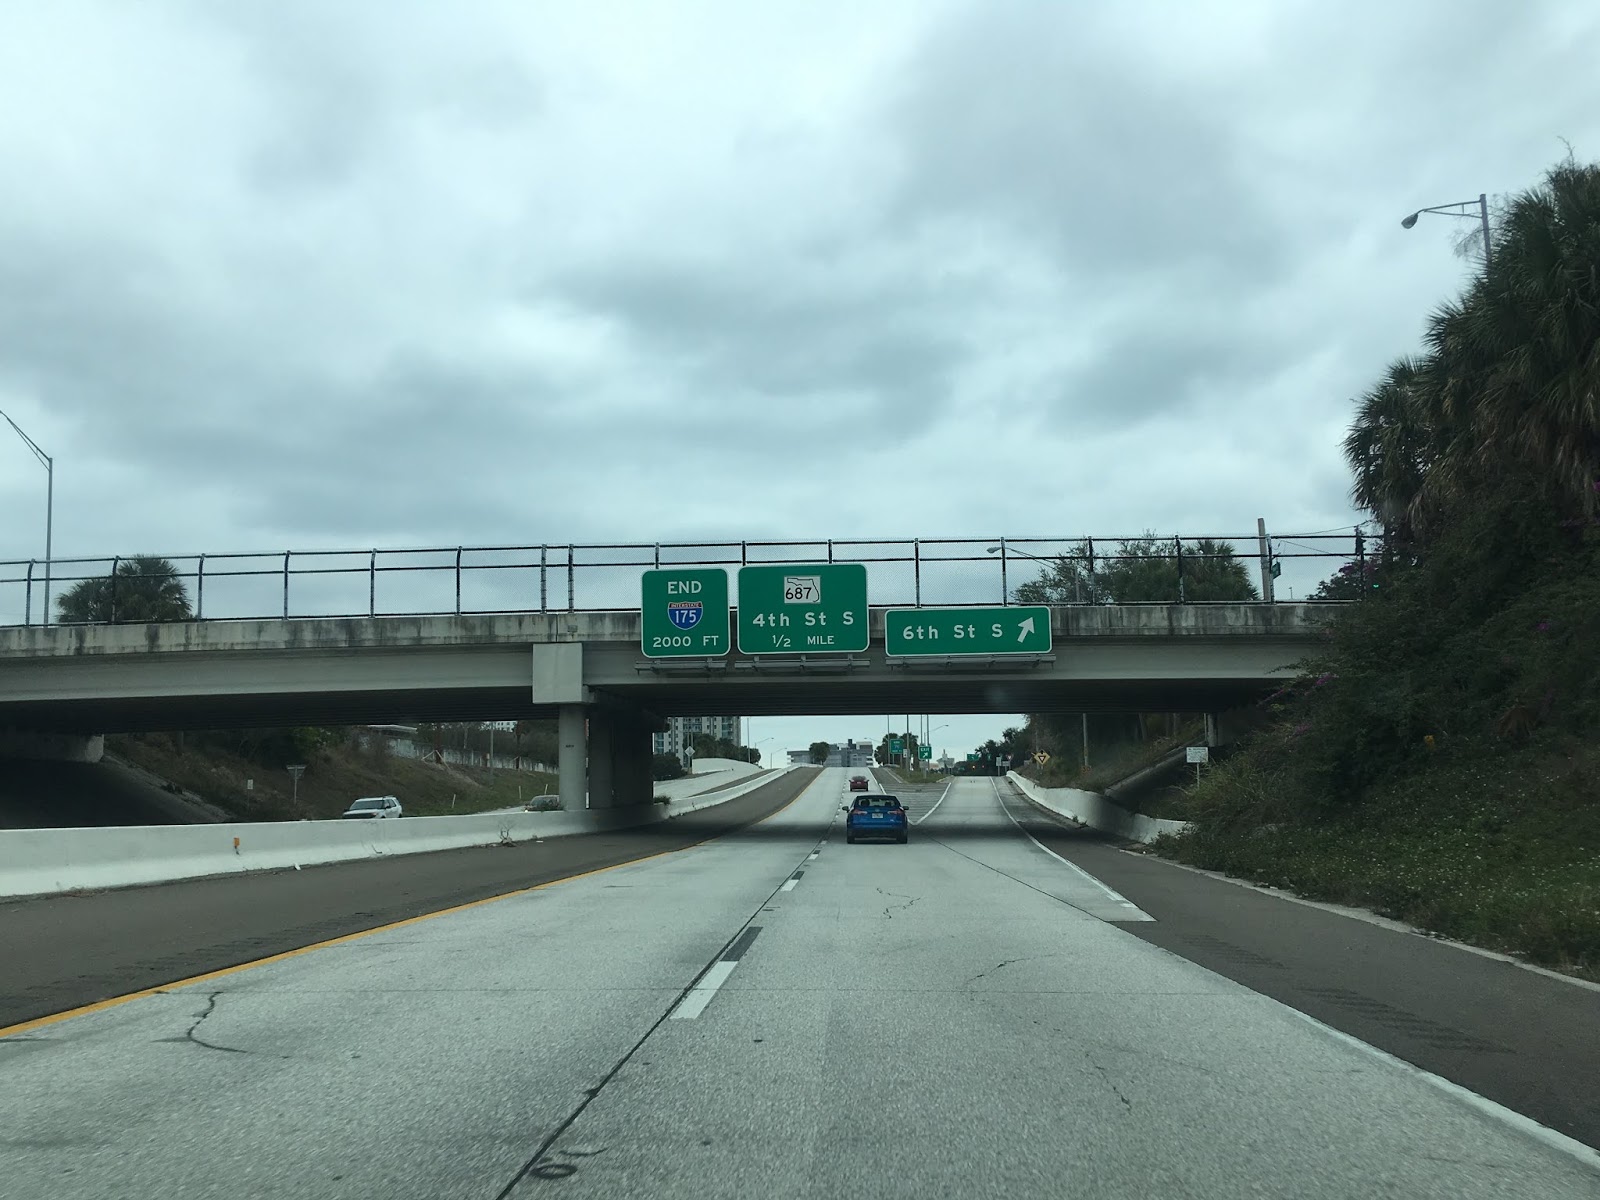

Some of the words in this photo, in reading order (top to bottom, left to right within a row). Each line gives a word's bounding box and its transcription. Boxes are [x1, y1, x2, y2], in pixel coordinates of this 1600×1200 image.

[667, 580, 702, 594] END
[785, 587, 812, 600] 687
[675, 609, 697, 624] 175
[752, 612, 790, 627] 4th
[804, 611, 827, 626] St
[842, 611, 854, 625] S
[902, 625, 939, 640] 6th
[953, 624, 976, 639] St
[991, 623, 1003, 638] S
[652, 635, 692, 648] 2000
[702, 635, 719, 647] FT
[807, 635, 835, 645] MILE
